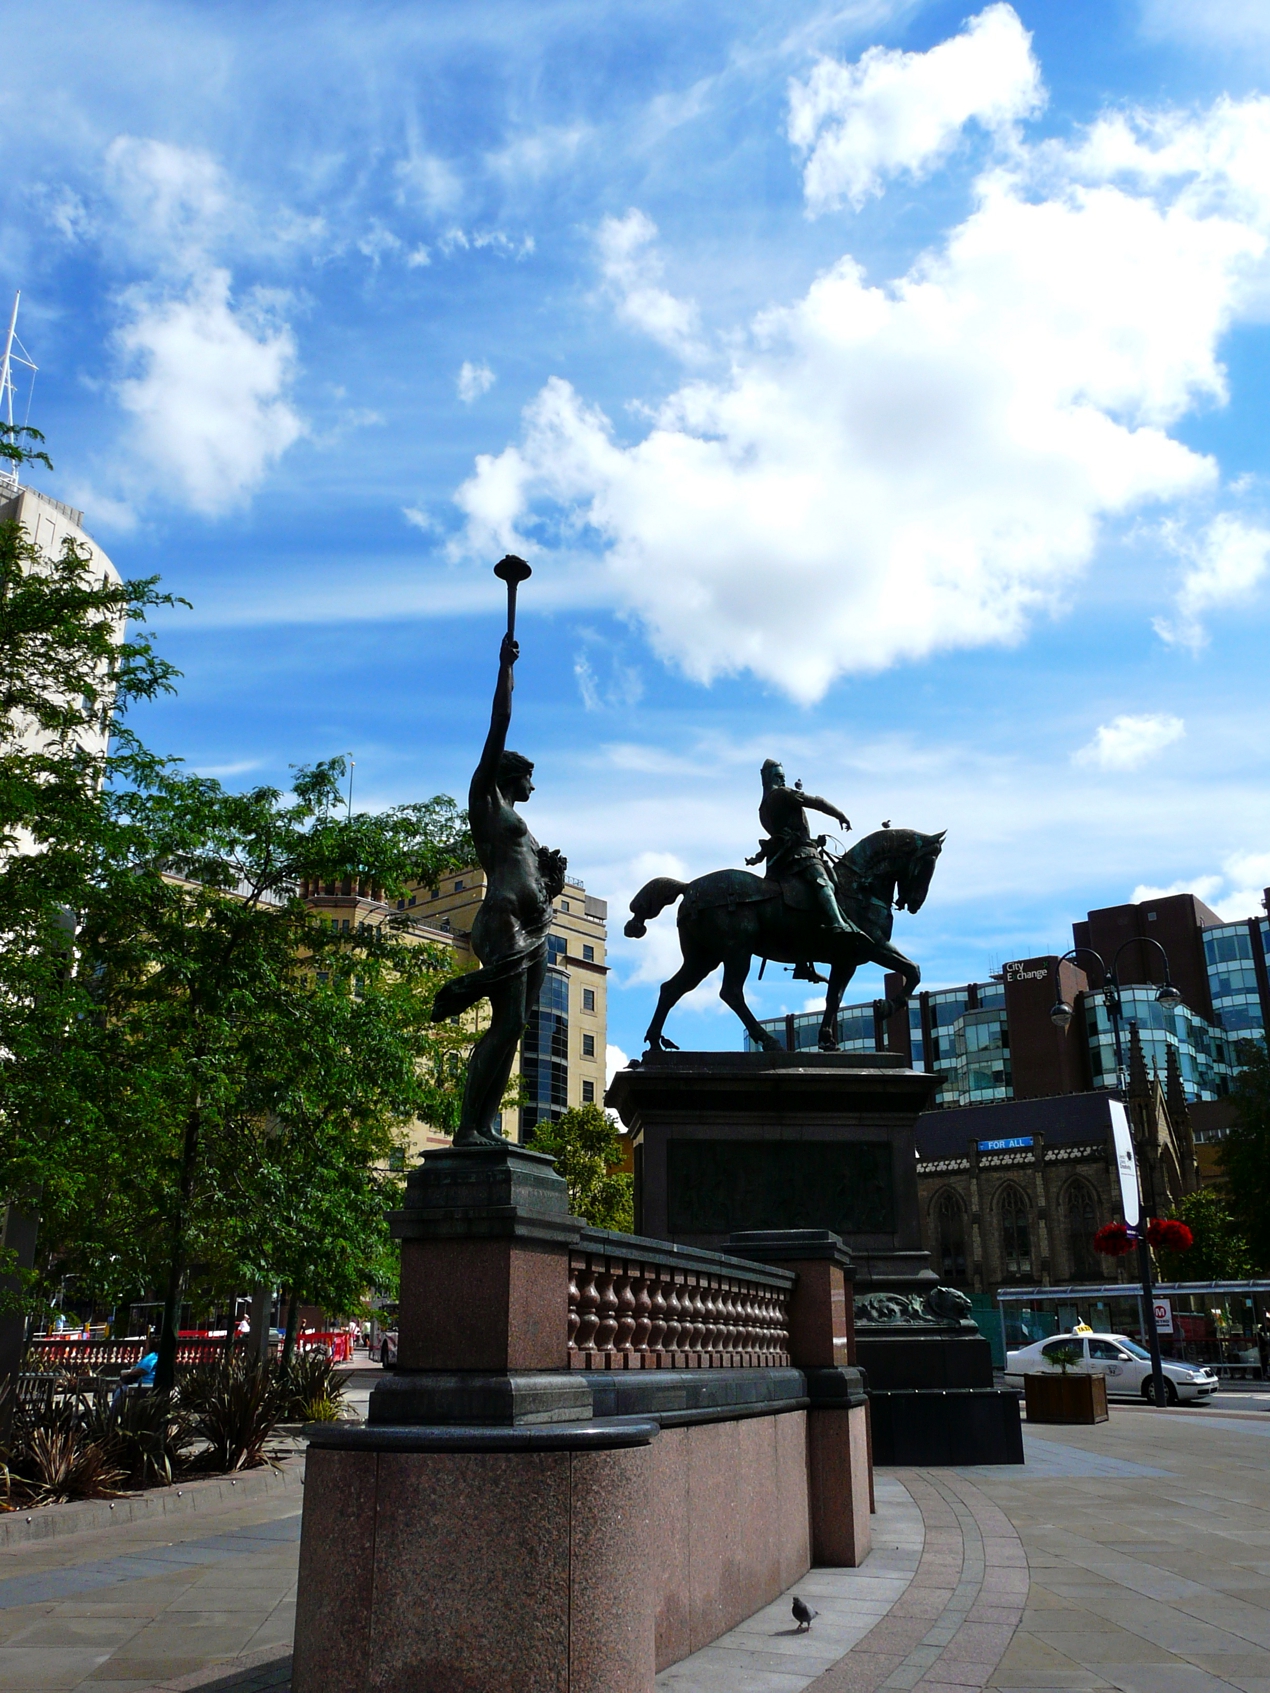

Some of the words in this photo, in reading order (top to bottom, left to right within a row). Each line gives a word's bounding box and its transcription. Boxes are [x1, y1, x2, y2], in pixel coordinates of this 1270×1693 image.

[1006, 962, 1024, 973] City
[988, 1141, 1006, 1150] FOR
[1009, 1139, 1025, 1148] ALL
